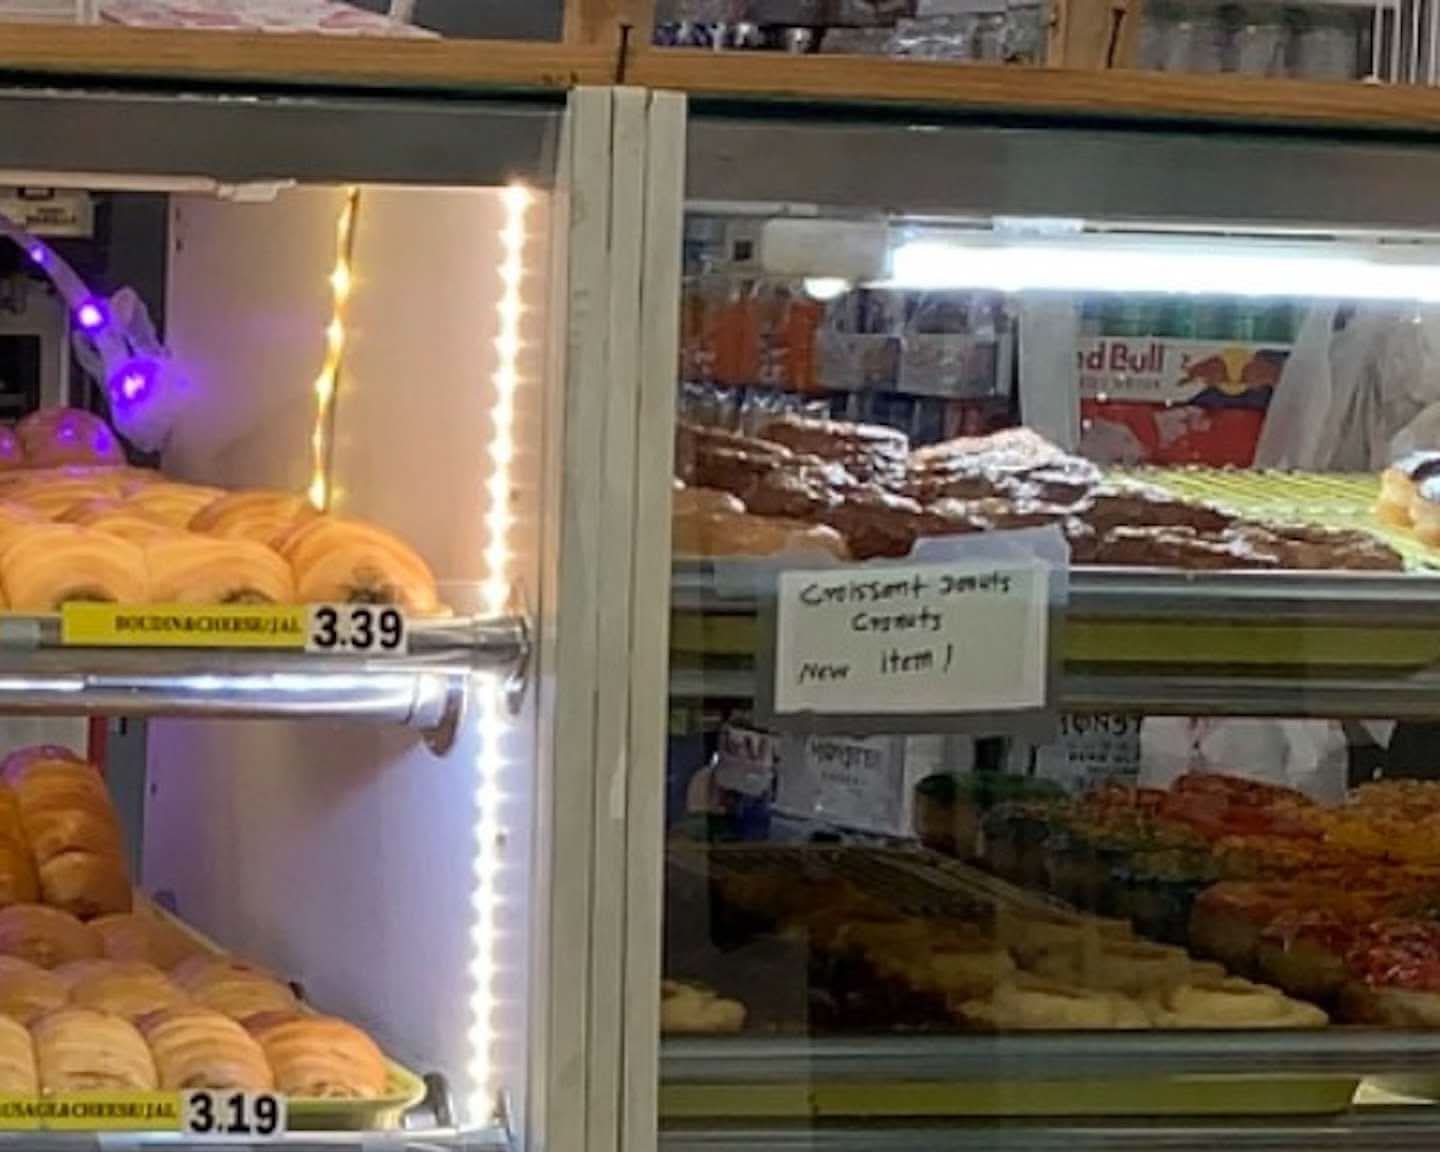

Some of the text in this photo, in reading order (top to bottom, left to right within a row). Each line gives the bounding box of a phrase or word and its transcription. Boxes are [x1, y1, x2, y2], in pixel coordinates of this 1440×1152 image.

[1110, 343, 1164, 373] Bull
[313, 607, 404, 649] 3.39
[189, 1092, 279, 1135] 3.19
